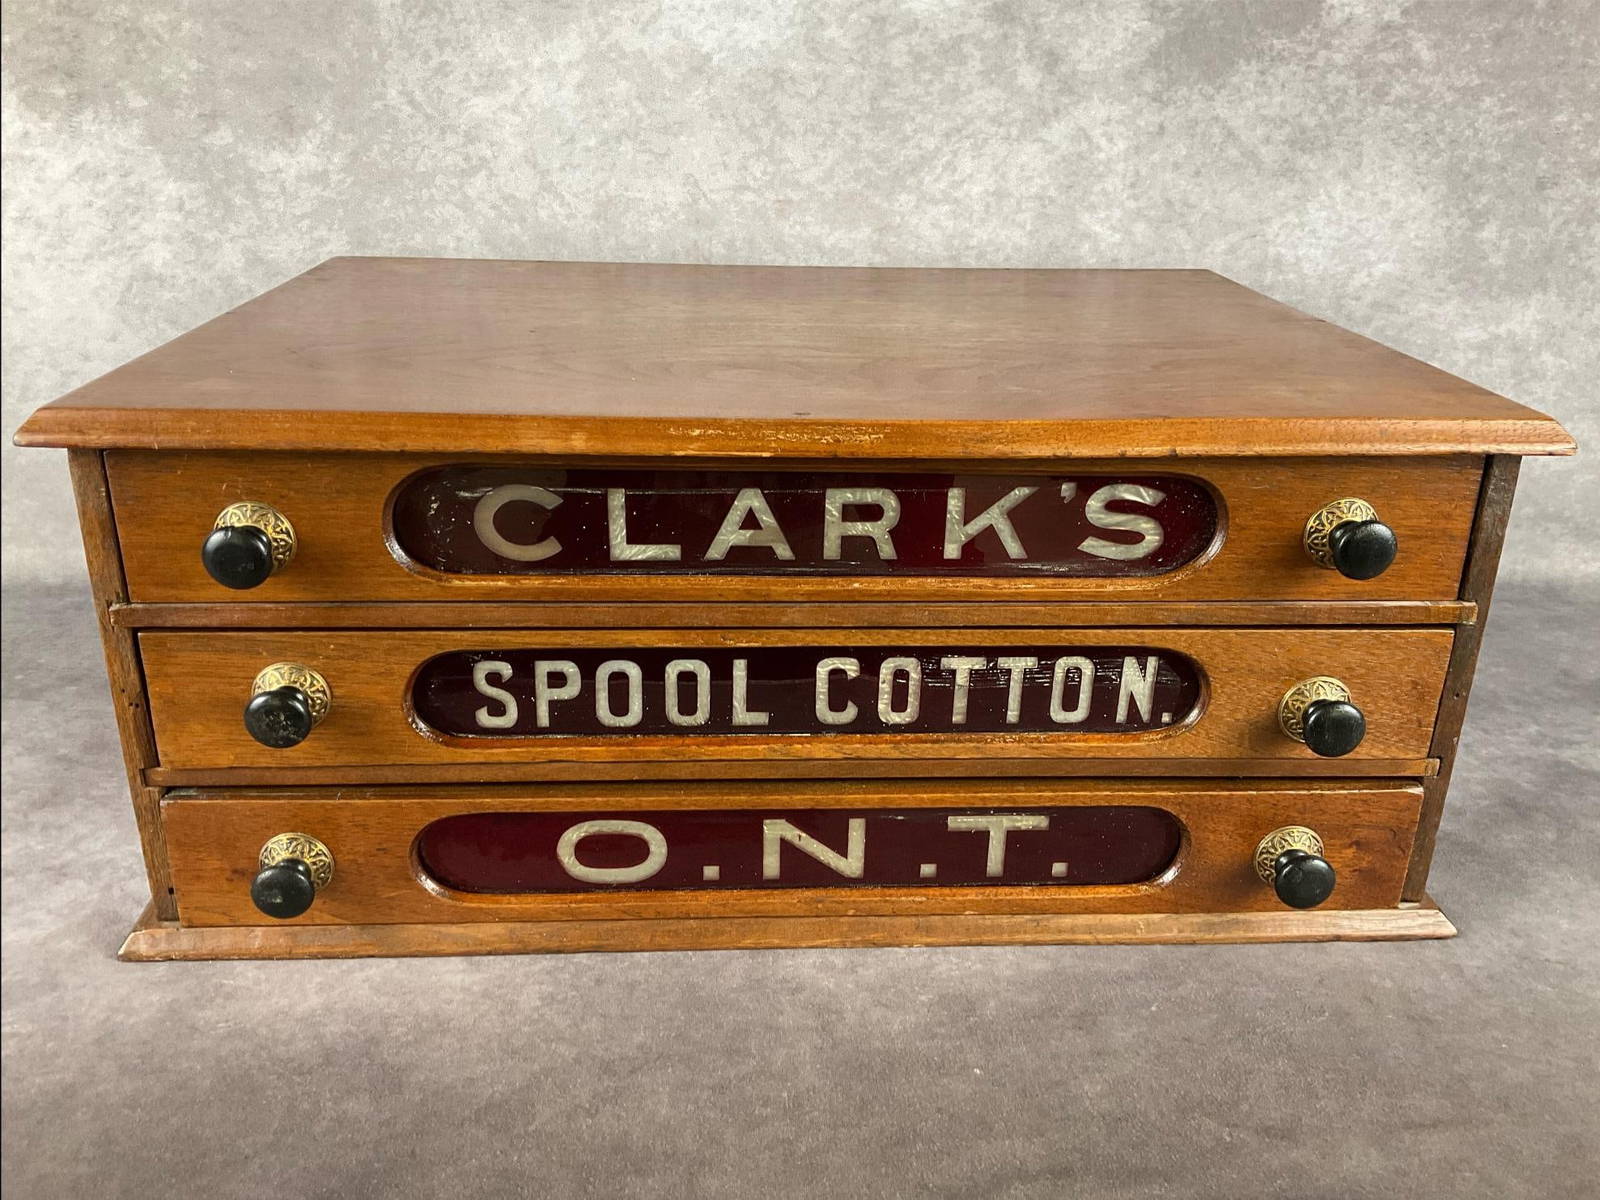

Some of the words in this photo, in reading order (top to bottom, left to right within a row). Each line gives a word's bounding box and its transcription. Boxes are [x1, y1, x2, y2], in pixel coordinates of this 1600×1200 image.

[473, 481, 1167, 562] CLARK'S
[472, 658, 769, 729] SPOOL
[815, 656, 1173, 726] COTTON.
[556, 815, 1069, 884] O.N.T.
